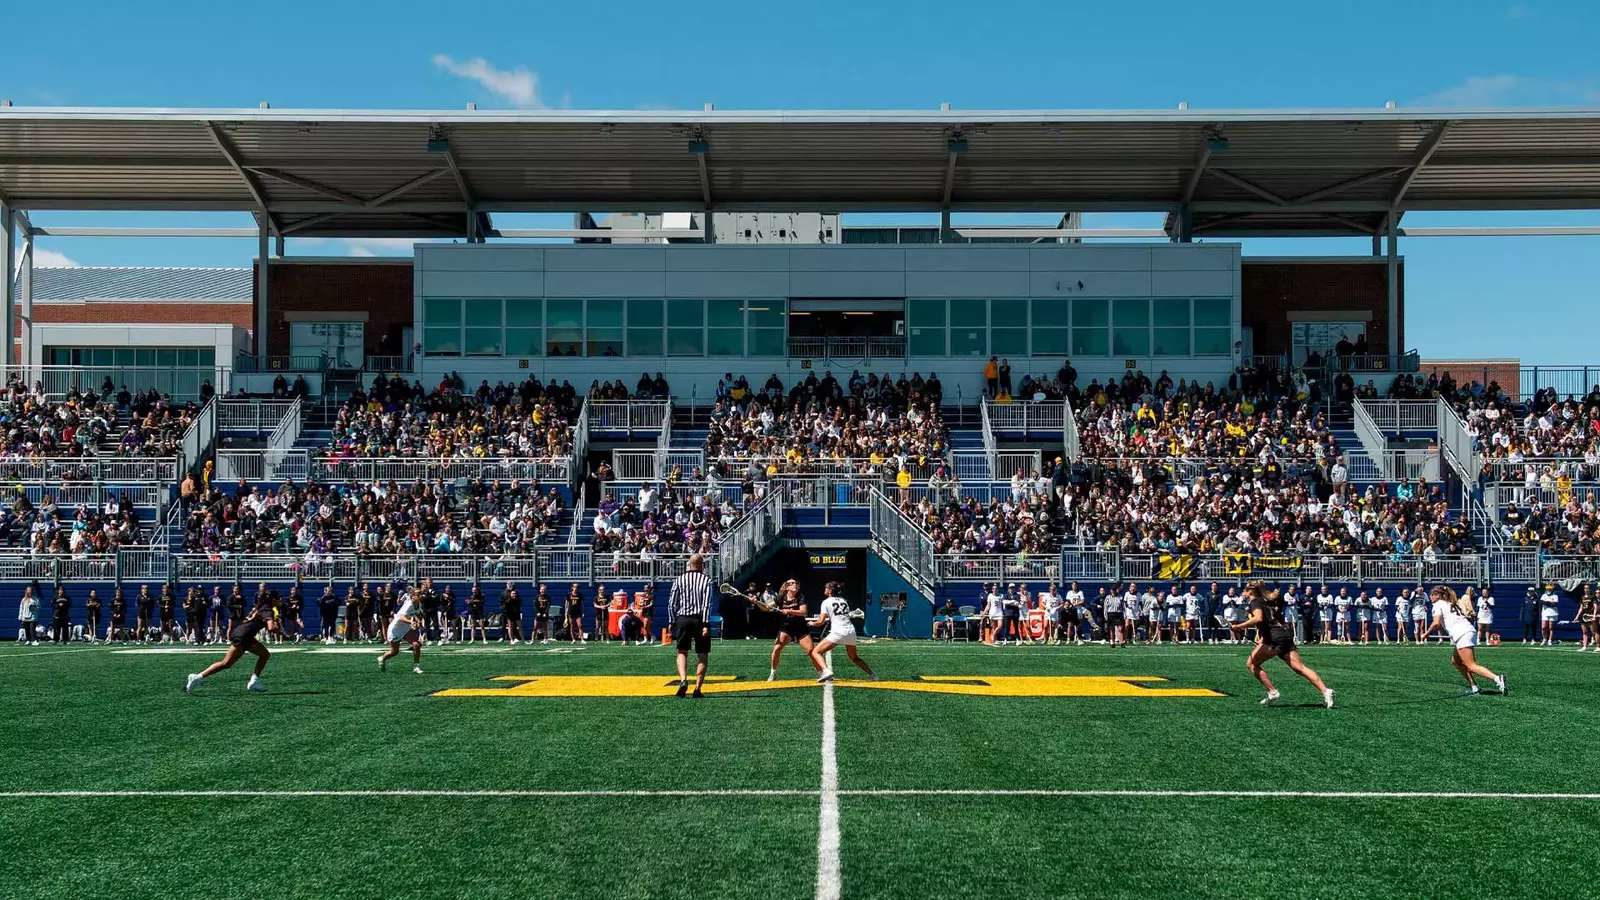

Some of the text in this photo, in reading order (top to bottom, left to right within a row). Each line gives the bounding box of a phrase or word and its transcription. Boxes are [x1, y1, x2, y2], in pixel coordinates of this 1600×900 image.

[810, 556, 820, 564] GO
[1158, 554, 1193, 579] M
[1229, 556, 1248, 571] M
[832, 602, 849, 616] 22
